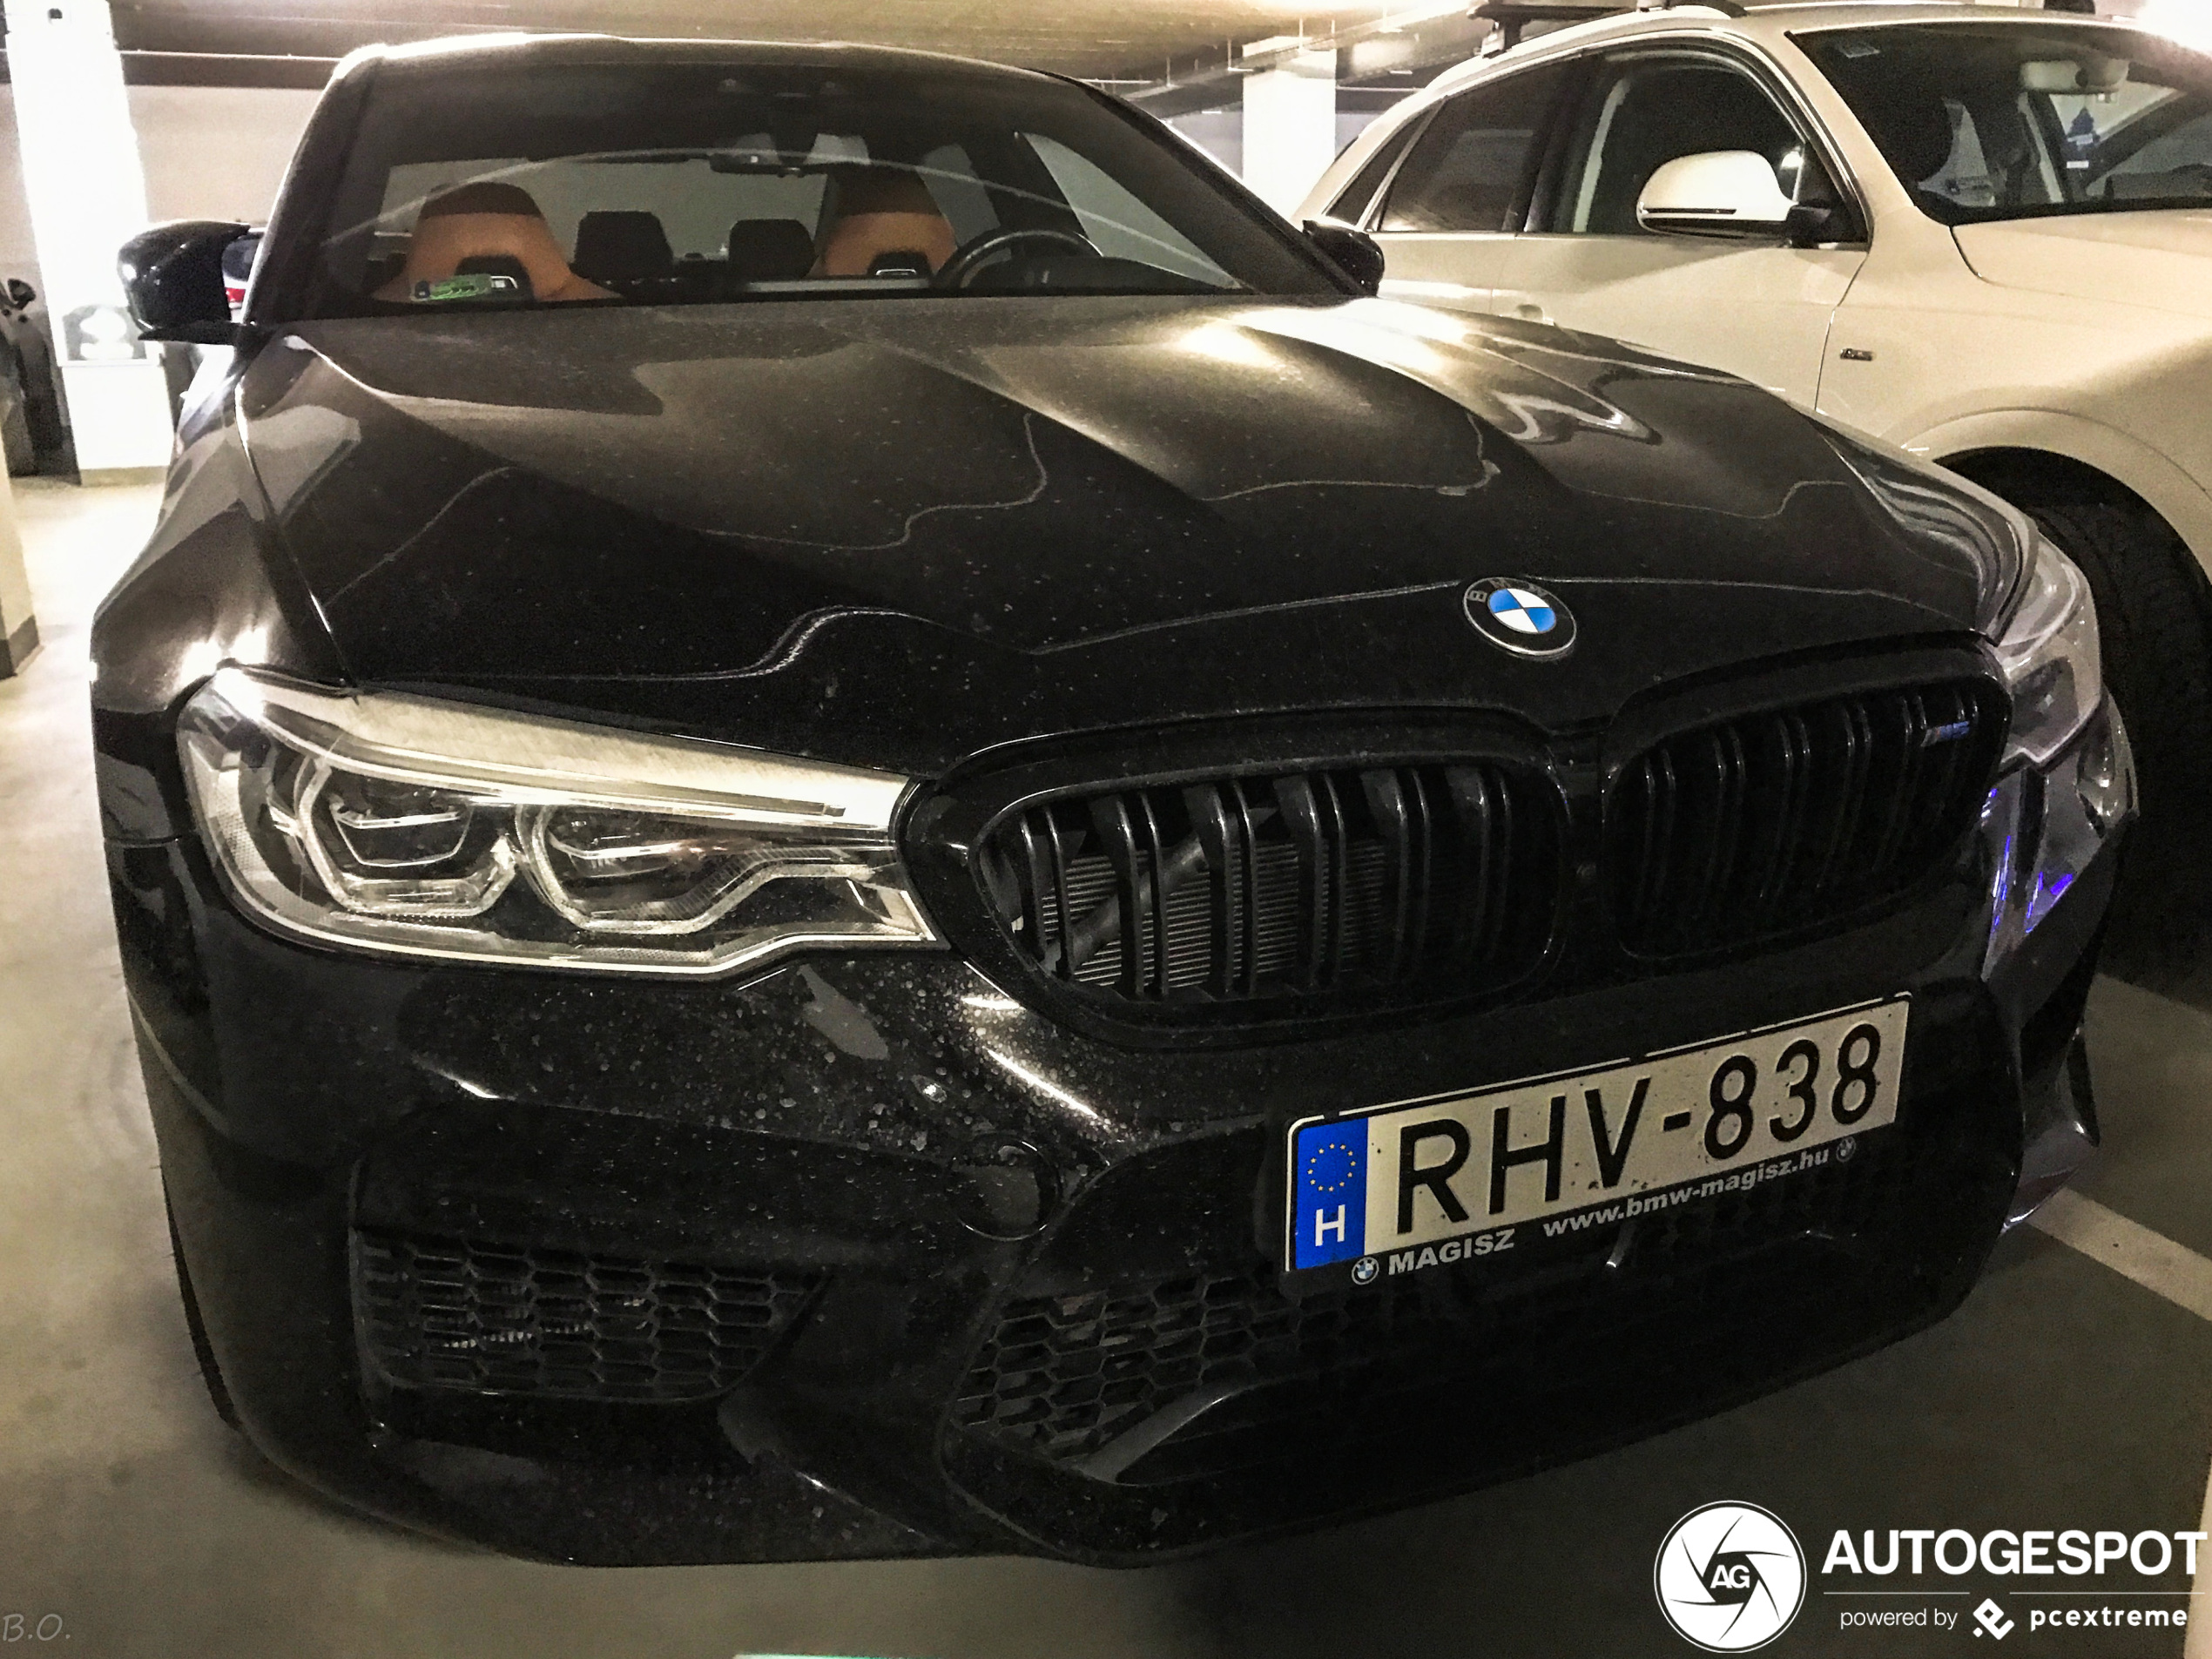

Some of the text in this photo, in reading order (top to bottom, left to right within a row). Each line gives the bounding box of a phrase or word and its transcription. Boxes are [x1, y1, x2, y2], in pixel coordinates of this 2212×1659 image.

[1397, 1023, 1881, 1236] RHV-838
[1315, 1204, 1346, 1247] H
[1388, 1148, 1829, 1275] MAGISZ www.bmw-magisz.hu
